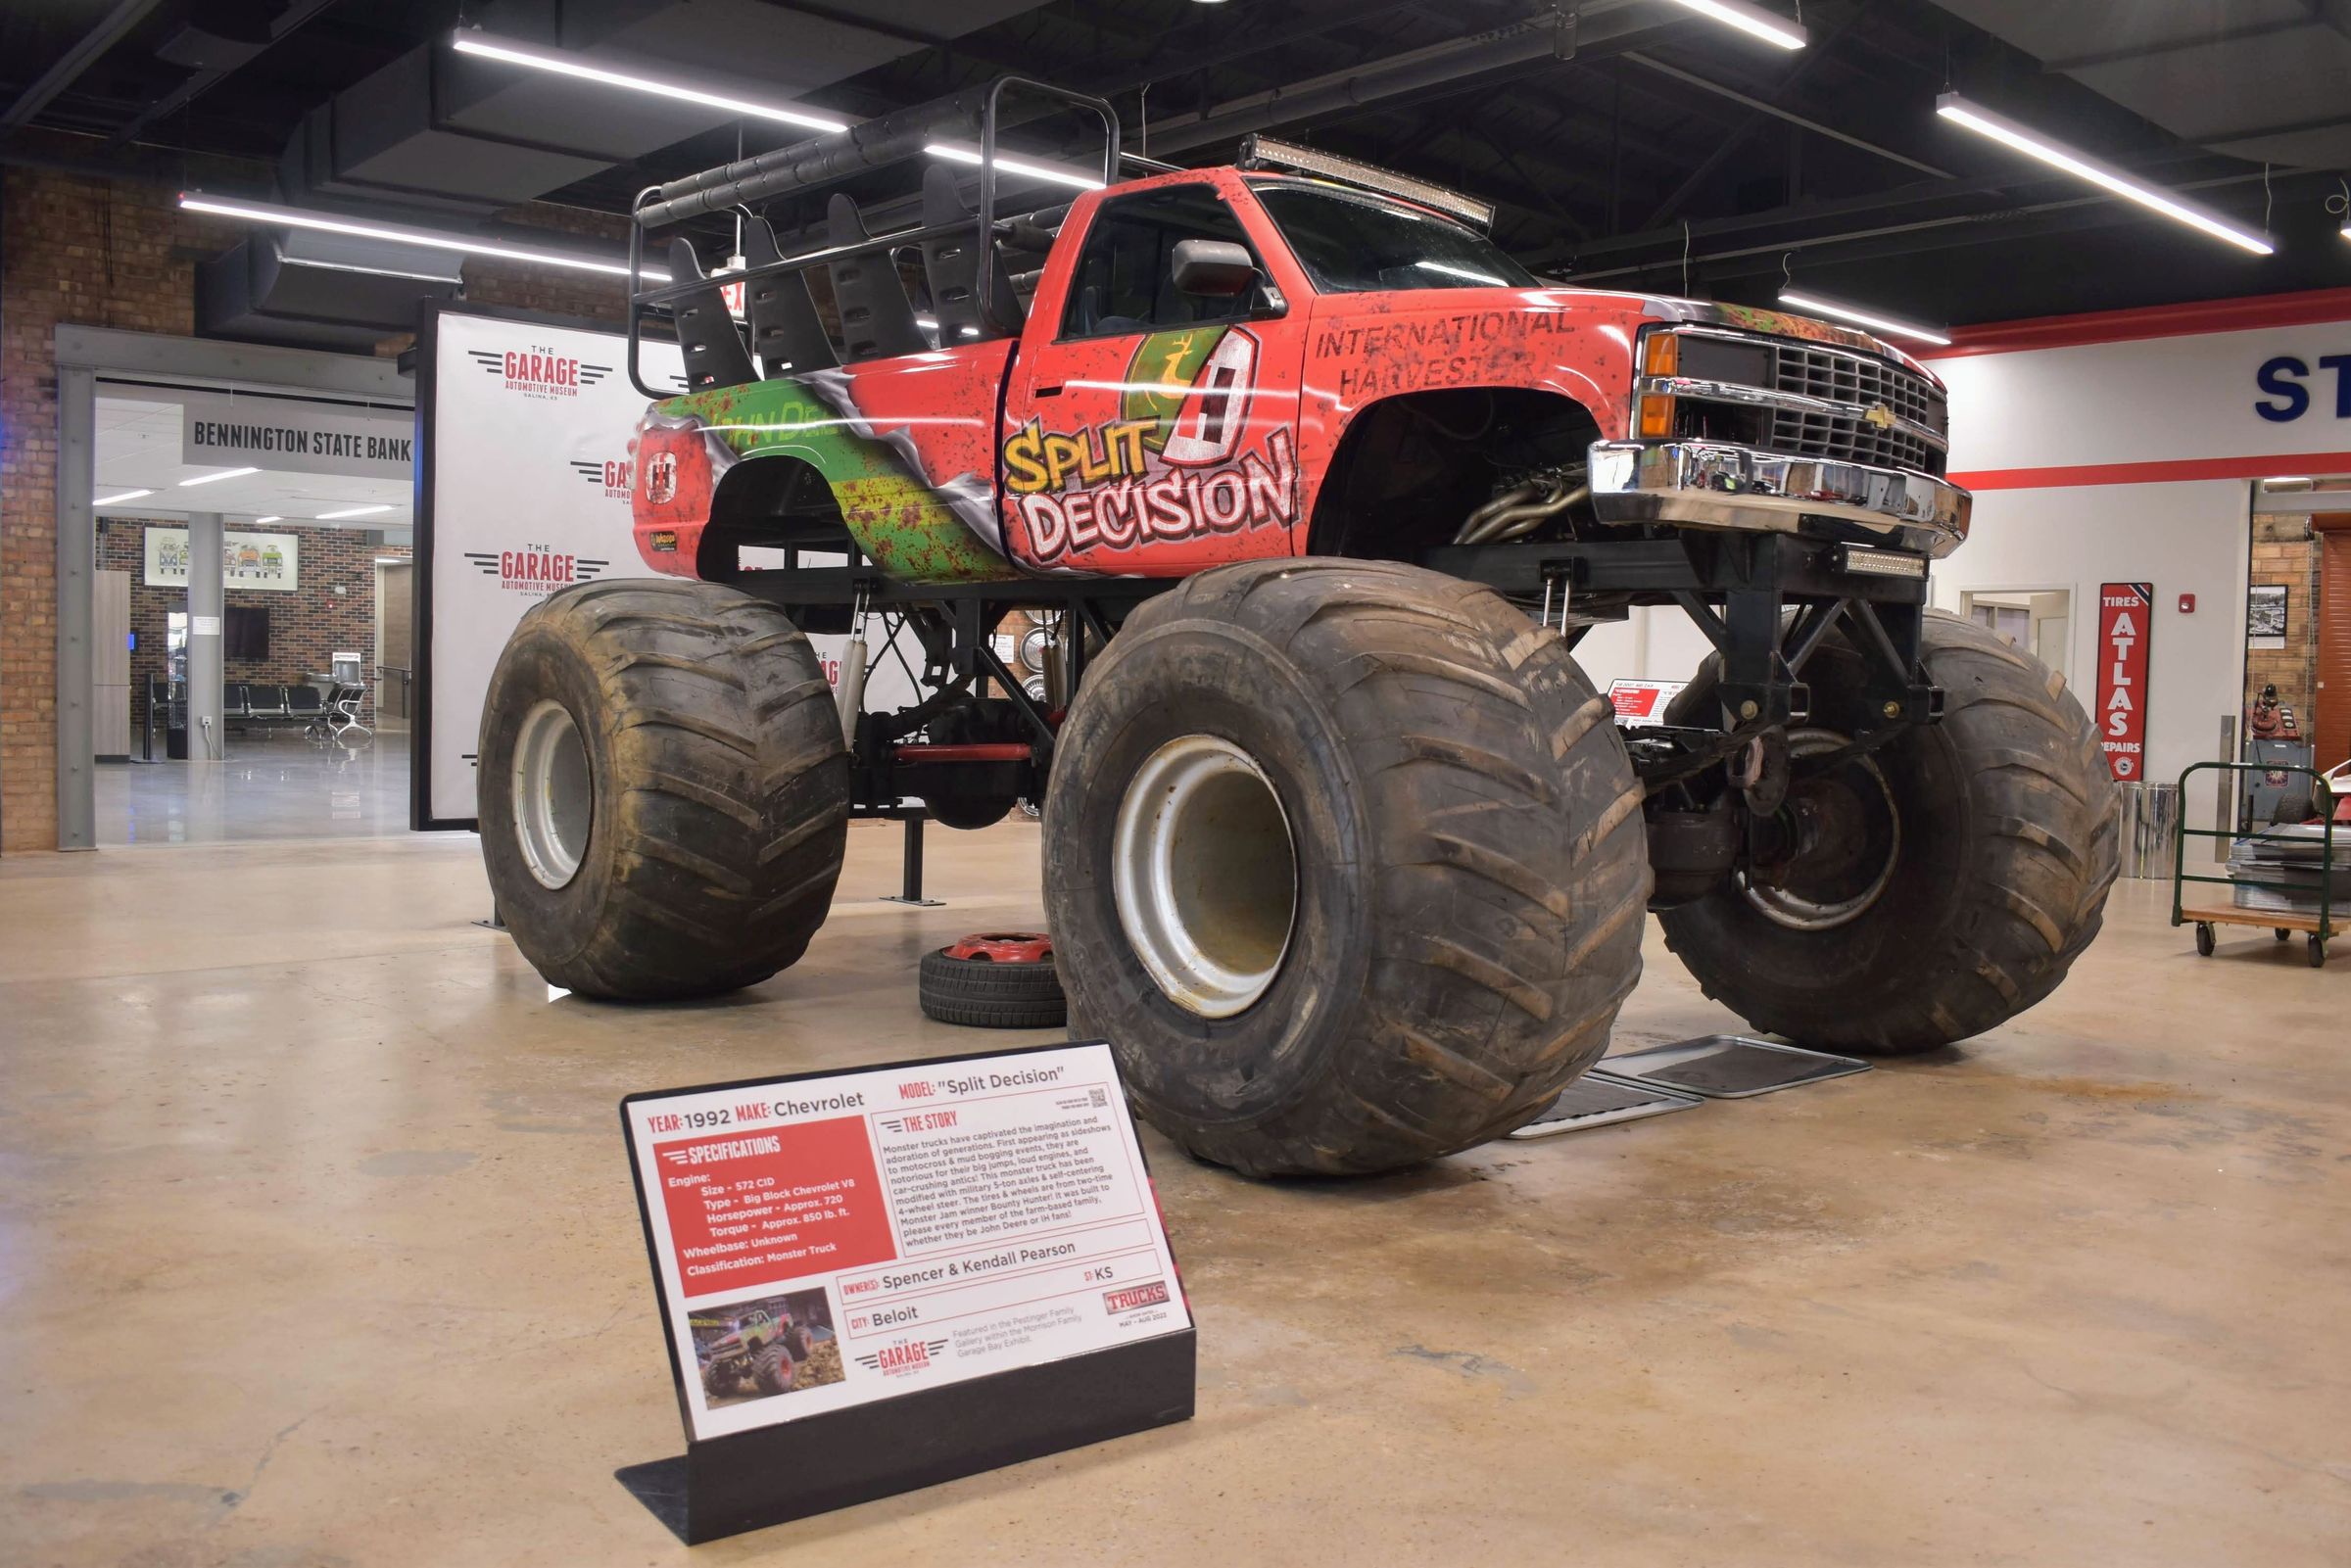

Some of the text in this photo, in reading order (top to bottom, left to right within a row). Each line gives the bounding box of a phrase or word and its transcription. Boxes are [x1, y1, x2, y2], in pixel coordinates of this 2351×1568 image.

[531, 345, 554, 356] THE
[1316, 310, 1575, 358] INTERNATIONAL
[504, 351, 578, 387] GARAGE
[1339, 350, 1536, 397] HARVESTER
[504, 380, 578, 397] AUTOMOTIVE MUSEUM
[194, 421, 411, 462] BENNINGTON STATE BANK
[1003, 417, 1160, 493] SPLIT
[1018, 425, 1299, 561] DECISION
[527, 543, 551, 552] THE
[501, 550, 575, 583] GARAGE
[501, 580, 545, 592] AUTOMOTIVE
[2102, 596, 2139, 607] TIRES
[2107, 612, 2136, 736] ATLAS
[2100, 741, 2140, 753] EPAIRS
[898, 1067, 1064, 1100] MODEL: "Split Decision"
[648, 1093, 864, 1133] YEAR: 1992 MAKE: Chevrolet
[902, 1111, 957, 1132] THE STORY
[689, 1135, 781, 1164] SPECIFICATIONS
[883, 1143, 919, 1154] Monster
[921, 1138, 948, 1149] trucks
[973, 1127, 1017, 1141] captivated
[1034, 1119, 1081, 1131] imagination
[886, 1152, 930, 1164] adoration
[931, 1148, 940, 1158] of
[942, 1143, 995, 1158] generations.
[996, 1138, 1016, 1147] First
[1018, 1132, 1059, 1145] appearing
[1072, 1125, 1111, 1136] sideshows
[890, 1172, 934, 1185] notorious
[950, 1165, 970, 1175] their
[972, 1164, 987, 1172] big
[988, 1160, 1017, 1170] jumps,
[1017, 1155, 1036, 1164] loud
[1038, 1151, 1073, 1162] engines,
[1074, 1147, 1088, 1156] and
[900, 1160, 947, 1172] motocross
[957, 1154, 977, 1164] mud
[978, 1150, 1014, 1161] bogging
[1015, 1145, 1045, 1155] events,
[668, 1174, 710, 1188] Engine:
[700, 1177, 775, 1197] Size 572 CID
[703, 1179, 855, 1211] Type Big Block Chevrolet V8
[893, 1180, 948, 1195] car-crushing
[950, 1174, 979, 1186] antics!
[1000, 1166, 1033, 1177] monster
[1035, 1162, 1057, 1172] truck
[895, 1192, 936, 1206] modified
[937, 1189, 957, 1198] with
[959, 1184, 991, 1195] military
[993, 1180, 1017, 1189] 5-ton
[1019, 1175, 1040, 1185] axles
[1049, 1165, 1104, 1180] self-centering
[898, 1203, 935, 1215] 4-wheel
[936, 1200, 961, 1210] steer.
[981, 1193, 1001, 1202] tires
[1010, 1186, 1039, 1196] wheels
[1056, 1180, 1076, 1189] from
[1077, 1174, 1113, 1185] two-time
[707, 1195, 843, 1223] Horsepower Approx. 720
[900, 1214, 936, 1226] Monster
[939, 1211, 958, 1219] Jam
[959, 1206, 988, 1215] winner
[990, 1200, 1021, 1211] Bounty
[1023, 1193, 1054, 1205] Hunter!
[1080, 1185, 1099, 1195] built
[903, 1226, 933, 1238] please
[935, 1221, 959, 1231] every
[961, 1214, 996, 1226] member
[999, 1211, 1008, 1219] of
[1026, 1200, 1073, 1214] farm-based
[1074, 1196, 1101, 1206] family,
[709, 1208, 849, 1237] Torque Approx. 850 lb. ft.
[905, 1235, 942, 1247] whether
[944, 1231, 964, 1240] they
[981, 1224, 1001, 1234] John
[1002, 1219, 1028, 1230] Deere
[1051, 1211, 1072, 1220] fans!
[683, 1234, 797, 1259] Wheelbase: Unknown
[687, 1243, 837, 1276] Classification: Monster Truck
[841, 1243, 1076, 1297] OWNER(S): Spencer & Kendall Pearson
[1094, 1266, 1113, 1280] KS
[1107, 1285, 1168, 1309] TRUCKS
[849, 1307, 918, 1330] CITY: Beloit
[952, 1325, 988, 1338] Featured
[998, 1320, 1012, 1329] the
[1049, 1307, 1074, 1317] Family
[955, 1337, 983, 1349] Gallery
[984, 1331, 1008, 1342] within
[1023, 1321, 1056, 1332] Morrison
[1057, 1315, 1081, 1325] Family
[879, 1342, 929, 1369] GARAGE
[957, 1335, 1032, 1358] Garage Bay Exhibit.
